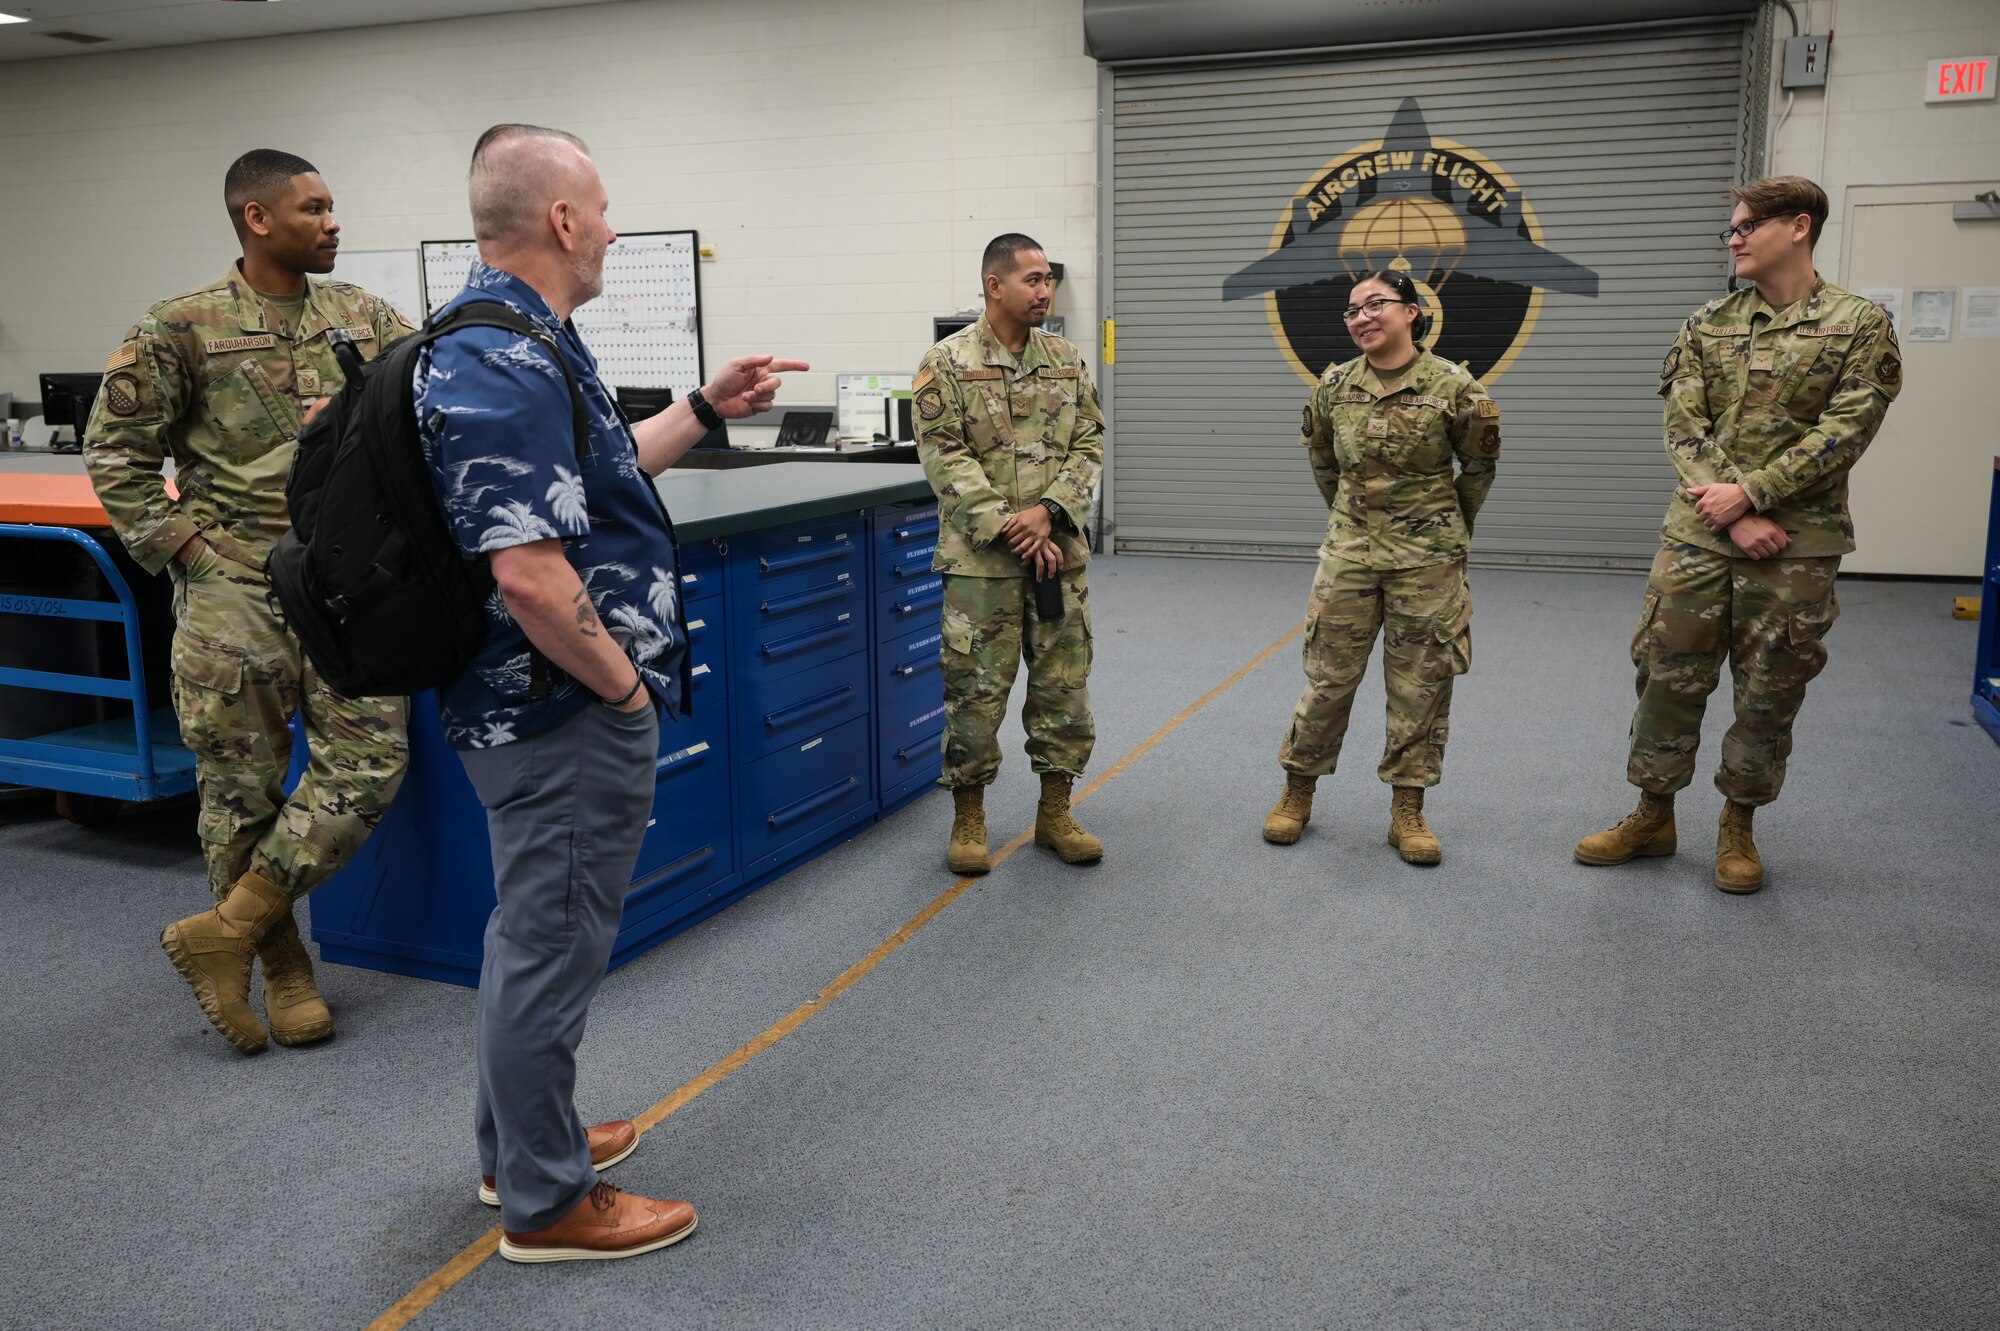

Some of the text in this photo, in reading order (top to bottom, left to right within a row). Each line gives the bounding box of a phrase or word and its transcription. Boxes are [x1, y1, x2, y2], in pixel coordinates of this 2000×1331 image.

[1939, 60, 1988, 95] EXIT
[1306, 151, 1509, 221] AIRCREW FLIGHT
[351, 327, 373, 339] FORCE
[1813, 327, 1825, 335] AIR
[1826, 325, 1851, 334] FORCE
[208, 336, 272, 351] FARQUHARSON
[1059, 368, 1077, 377] FORCE
[1337, 394, 1365, 402] NAVARRO
[1425, 396, 1446, 406] FORCE
[905, 512, 926, 522] FLYERS
[907, 548, 927, 558] FLYERS
[908, 584, 928, 595] FLYERS
[909, 638, 929, 651] FLYERS
[910, 714, 929, 728] FLYERS
